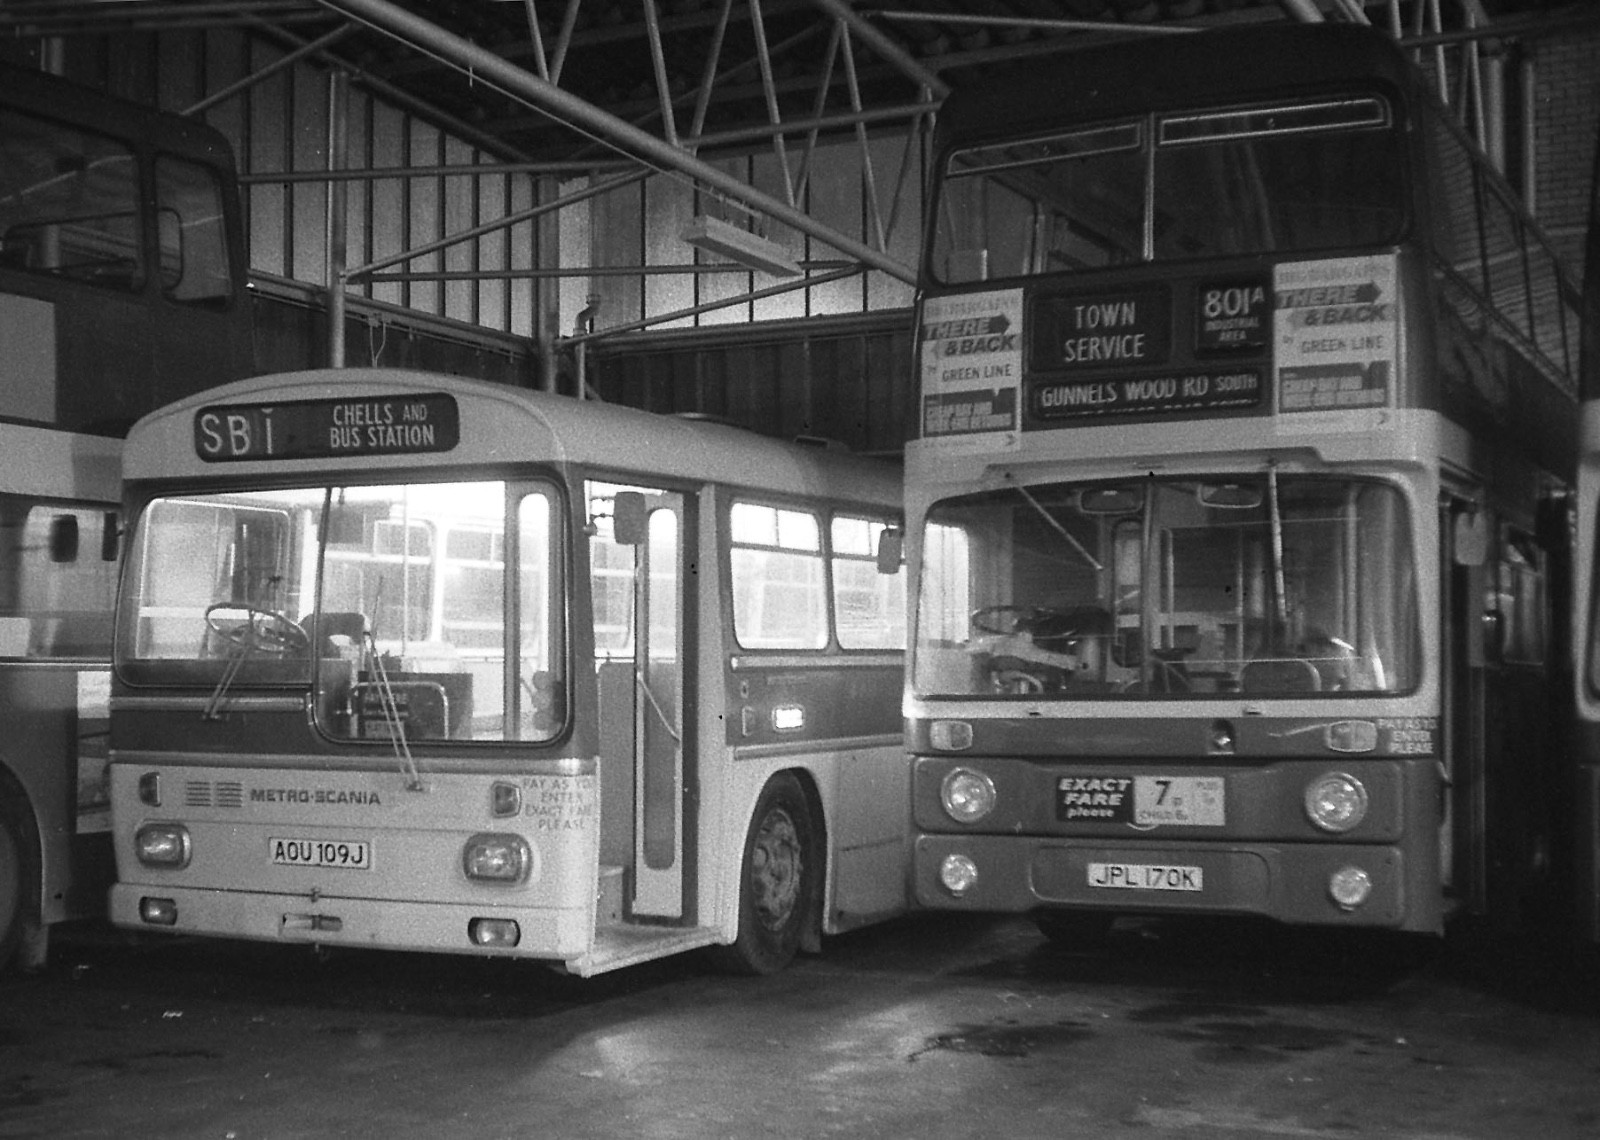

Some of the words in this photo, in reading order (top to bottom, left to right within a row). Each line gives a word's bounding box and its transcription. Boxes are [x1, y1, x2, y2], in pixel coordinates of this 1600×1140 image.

[1075, 302, 1135, 329] TOWN
[924, 317, 990, 340] THERE
[1219, 330, 1247, 341] AREA
[1065, 334, 1145, 362] SERVICE
[1302, 339, 1345, 353] GREEN
[1352, 335, 1384, 350] LINE
[942, 366, 979, 382] GREEN
[984, 364, 1011, 378] LINE
[1041, 383, 1118, 407] GUNNELS
[1125, 378, 1176, 400] WOOD
[1183, 375, 1209, 396] RD
[1215, 373, 1258, 391] SOUTH
[333, 403, 394, 426] CHELLS
[403, 404, 428, 421] AND
[330, 426, 360, 448] BUS
[367, 424, 435, 447] STATION
[523, 778, 545, 790] PAY
[1059, 778, 1131, 791] EXACT
[1064, 792, 1124, 805] FARE
[1067, 807, 1114, 819] please
[538, 818, 585, 831] PLEASE
[317, 843, 363, 865] 109J
[1096, 866, 1138, 886] JPL
[1145, 867, 1194, 888] 170K
